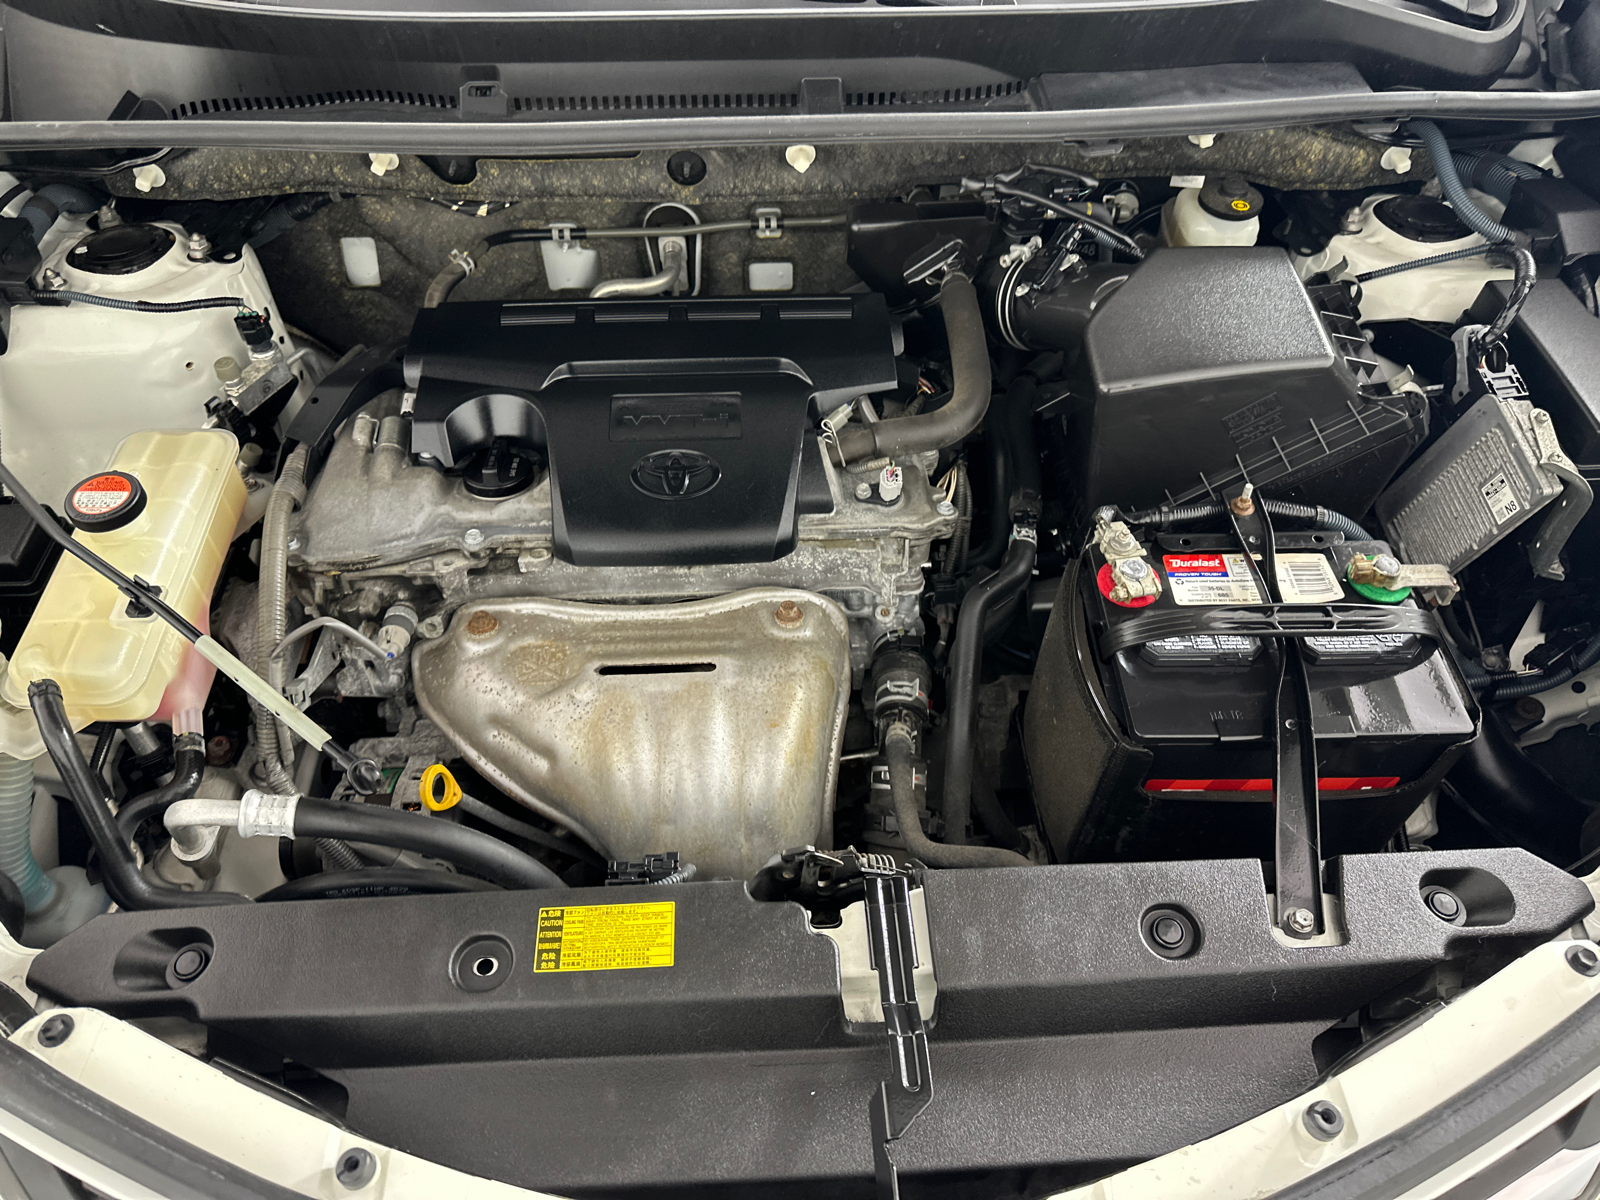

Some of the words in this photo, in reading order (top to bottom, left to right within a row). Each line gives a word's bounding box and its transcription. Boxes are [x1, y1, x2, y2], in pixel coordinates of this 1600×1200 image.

[1504, 500, 1518, 515] N8
[1169, 559, 1221, 567] Duralast
[541, 919, 563, 927] CAUTION
